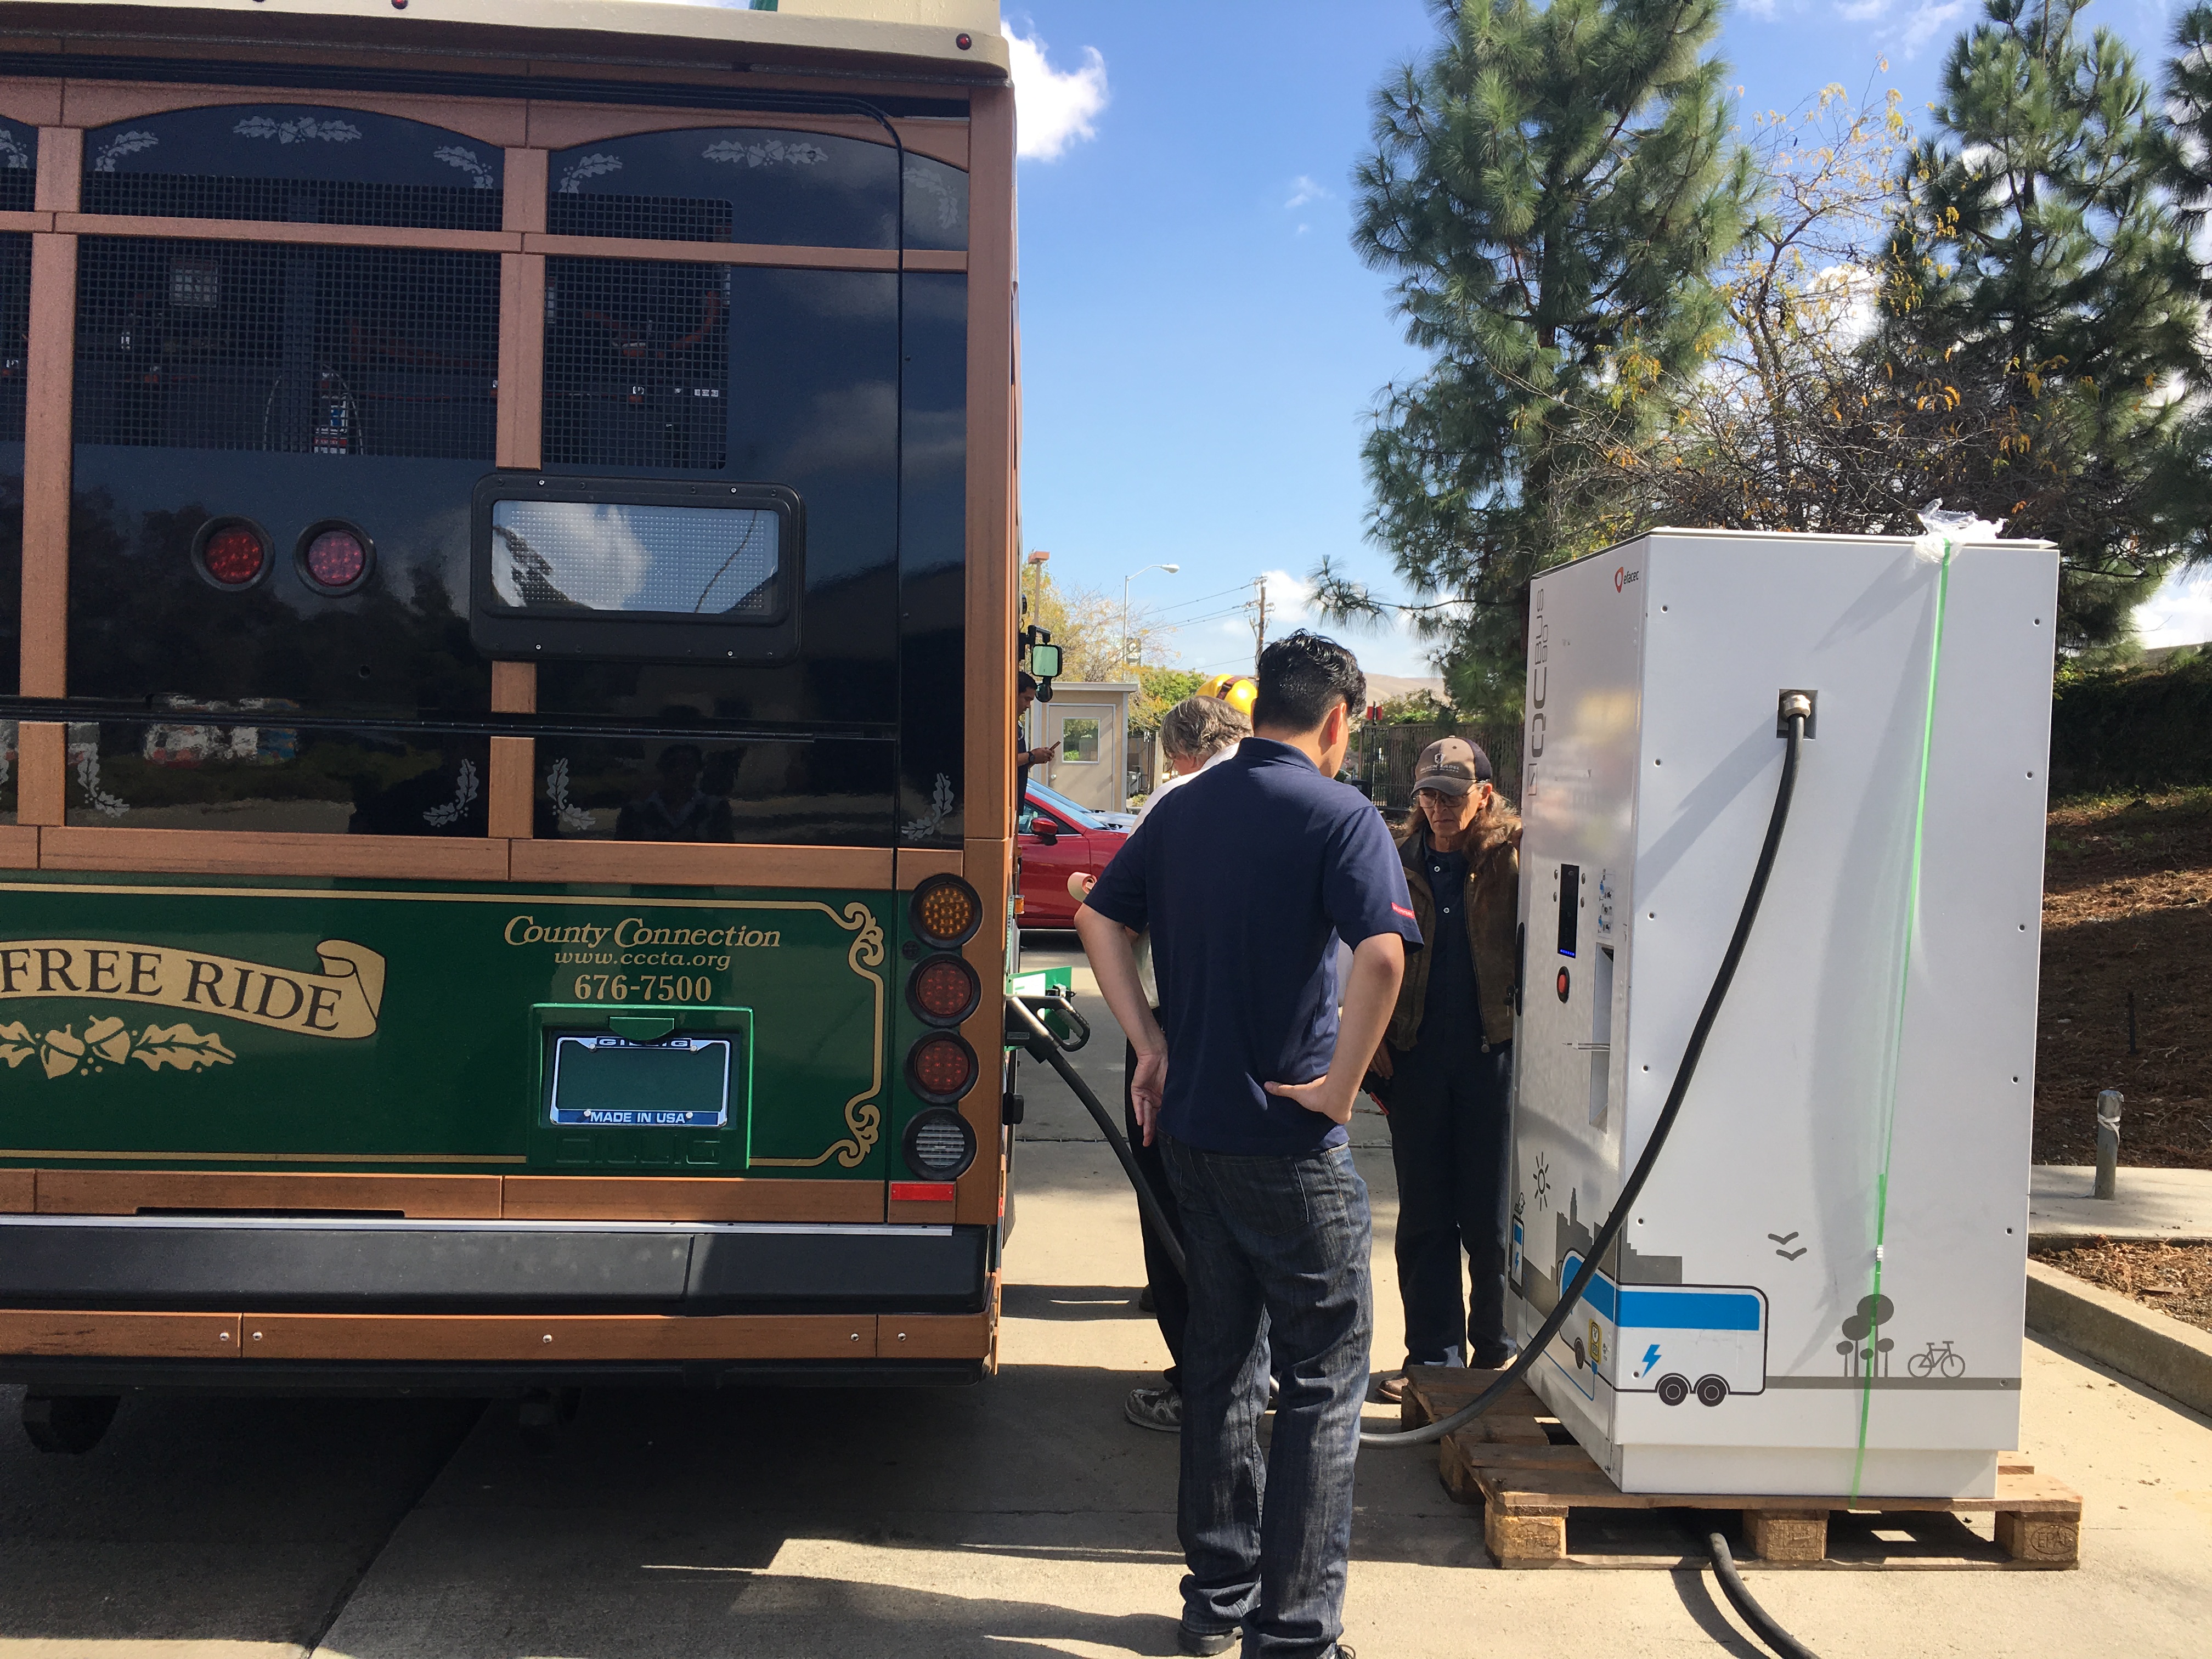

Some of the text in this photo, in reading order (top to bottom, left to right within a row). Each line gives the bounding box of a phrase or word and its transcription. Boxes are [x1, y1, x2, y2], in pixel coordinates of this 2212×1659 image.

[1624, 571, 1639, 584] efacec
[504, 916, 781, 948] County Connection
[554, 952, 731, 971] www.cccta.org
[0, 947, 342, 1031] FREE RIDE
[574, 974, 712, 1002] 676-7500
[599, 1038, 688, 1047] GIG
[590, 1111, 685, 1124] MADE IN USA
